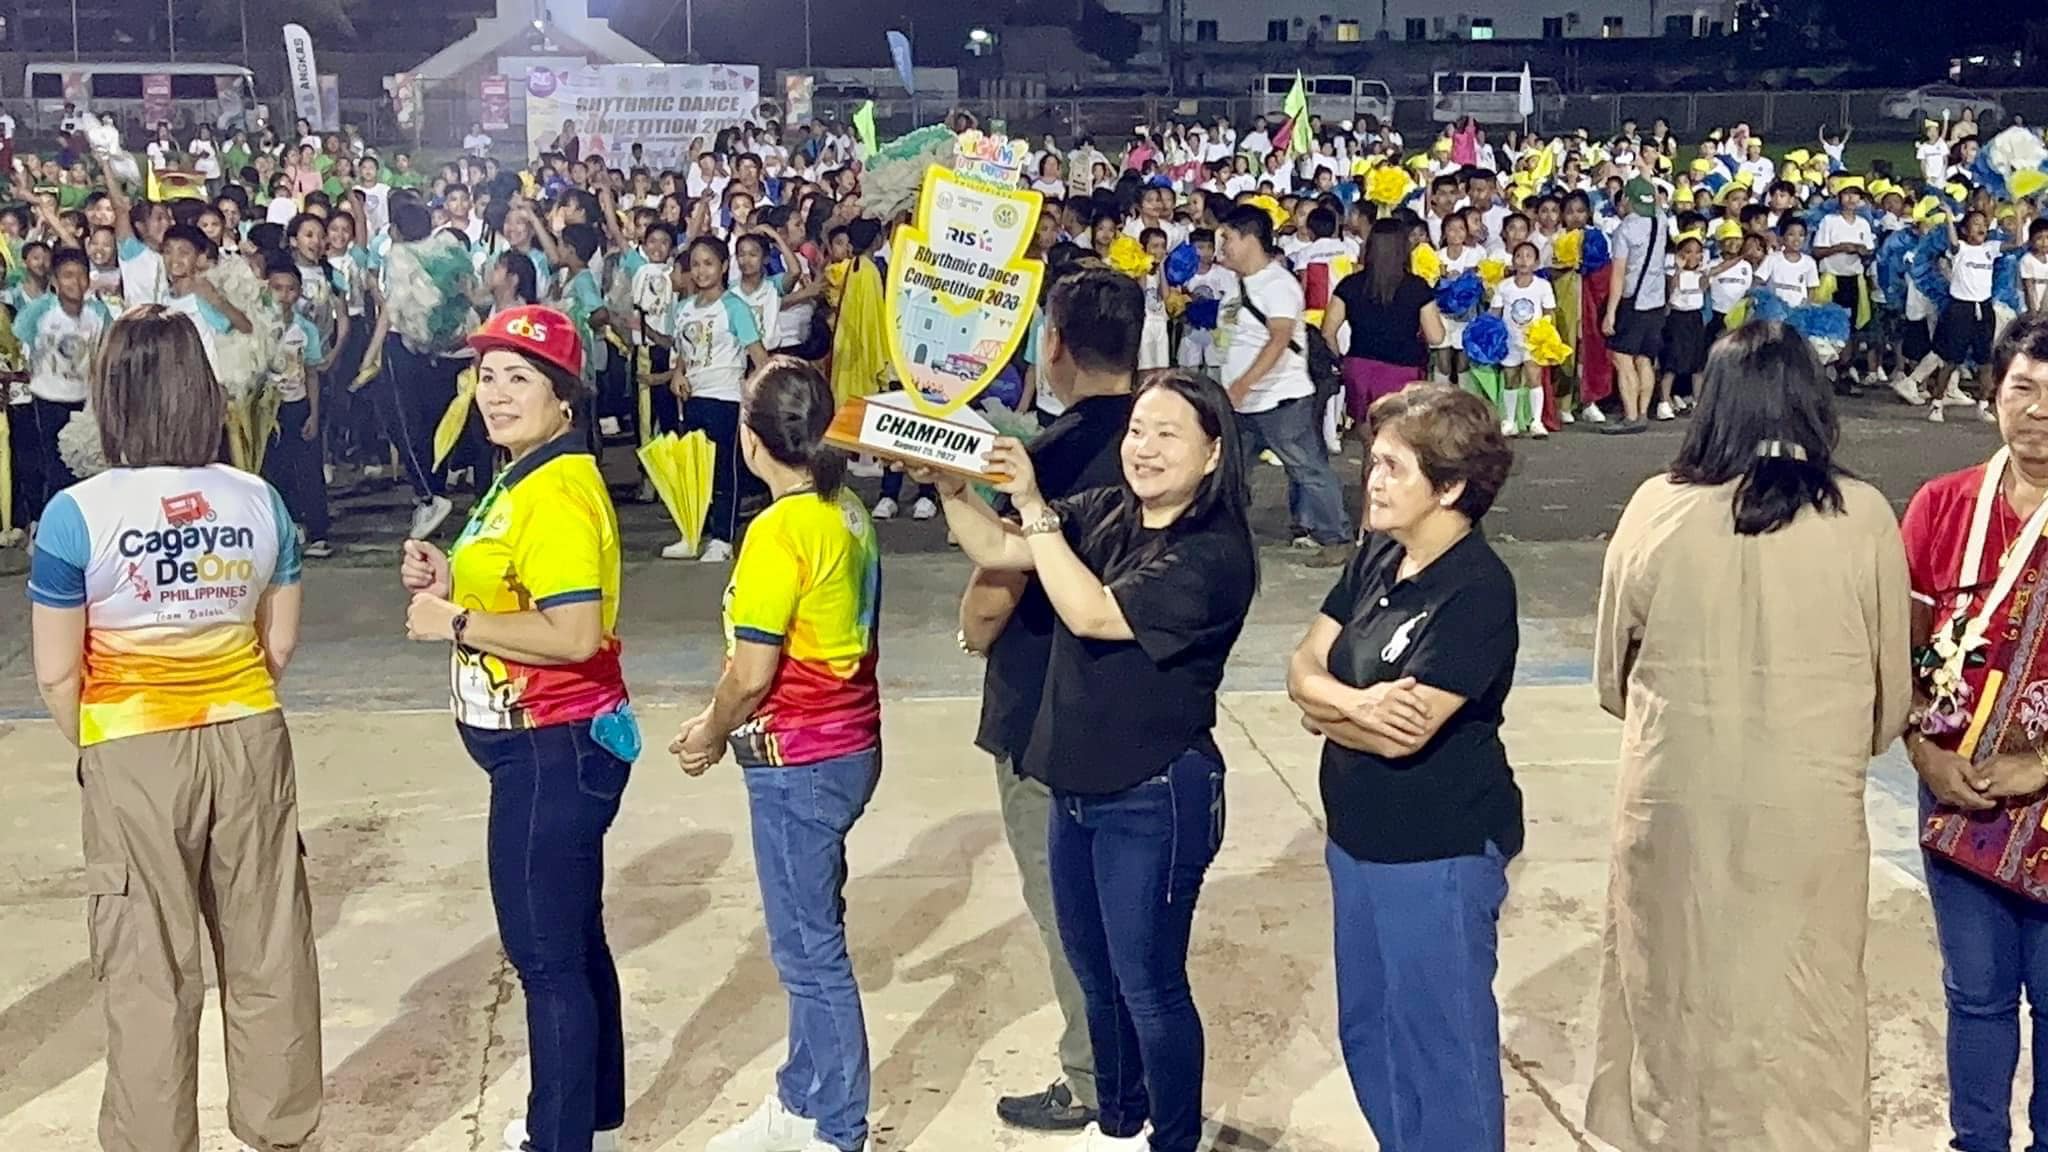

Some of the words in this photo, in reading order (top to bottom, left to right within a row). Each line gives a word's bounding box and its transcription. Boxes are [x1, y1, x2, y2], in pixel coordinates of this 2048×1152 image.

[293, 38, 310, 90] ANGKAS
[575, 96, 674, 113] RHYTHMIC
[575, 118, 698, 134] COMPETITION
[945, 226, 977, 246] RIS
[914, 245, 977, 276] Rhythmic
[977, 262, 1020, 287] Dance
[903, 266, 984, 303] Competition
[985, 288, 1021, 311] 2023
[875, 413, 981, 455] CHAMPION
[119, 526, 254, 558] Cagayan
[160, 585, 248, 603] PHILIPPINES
